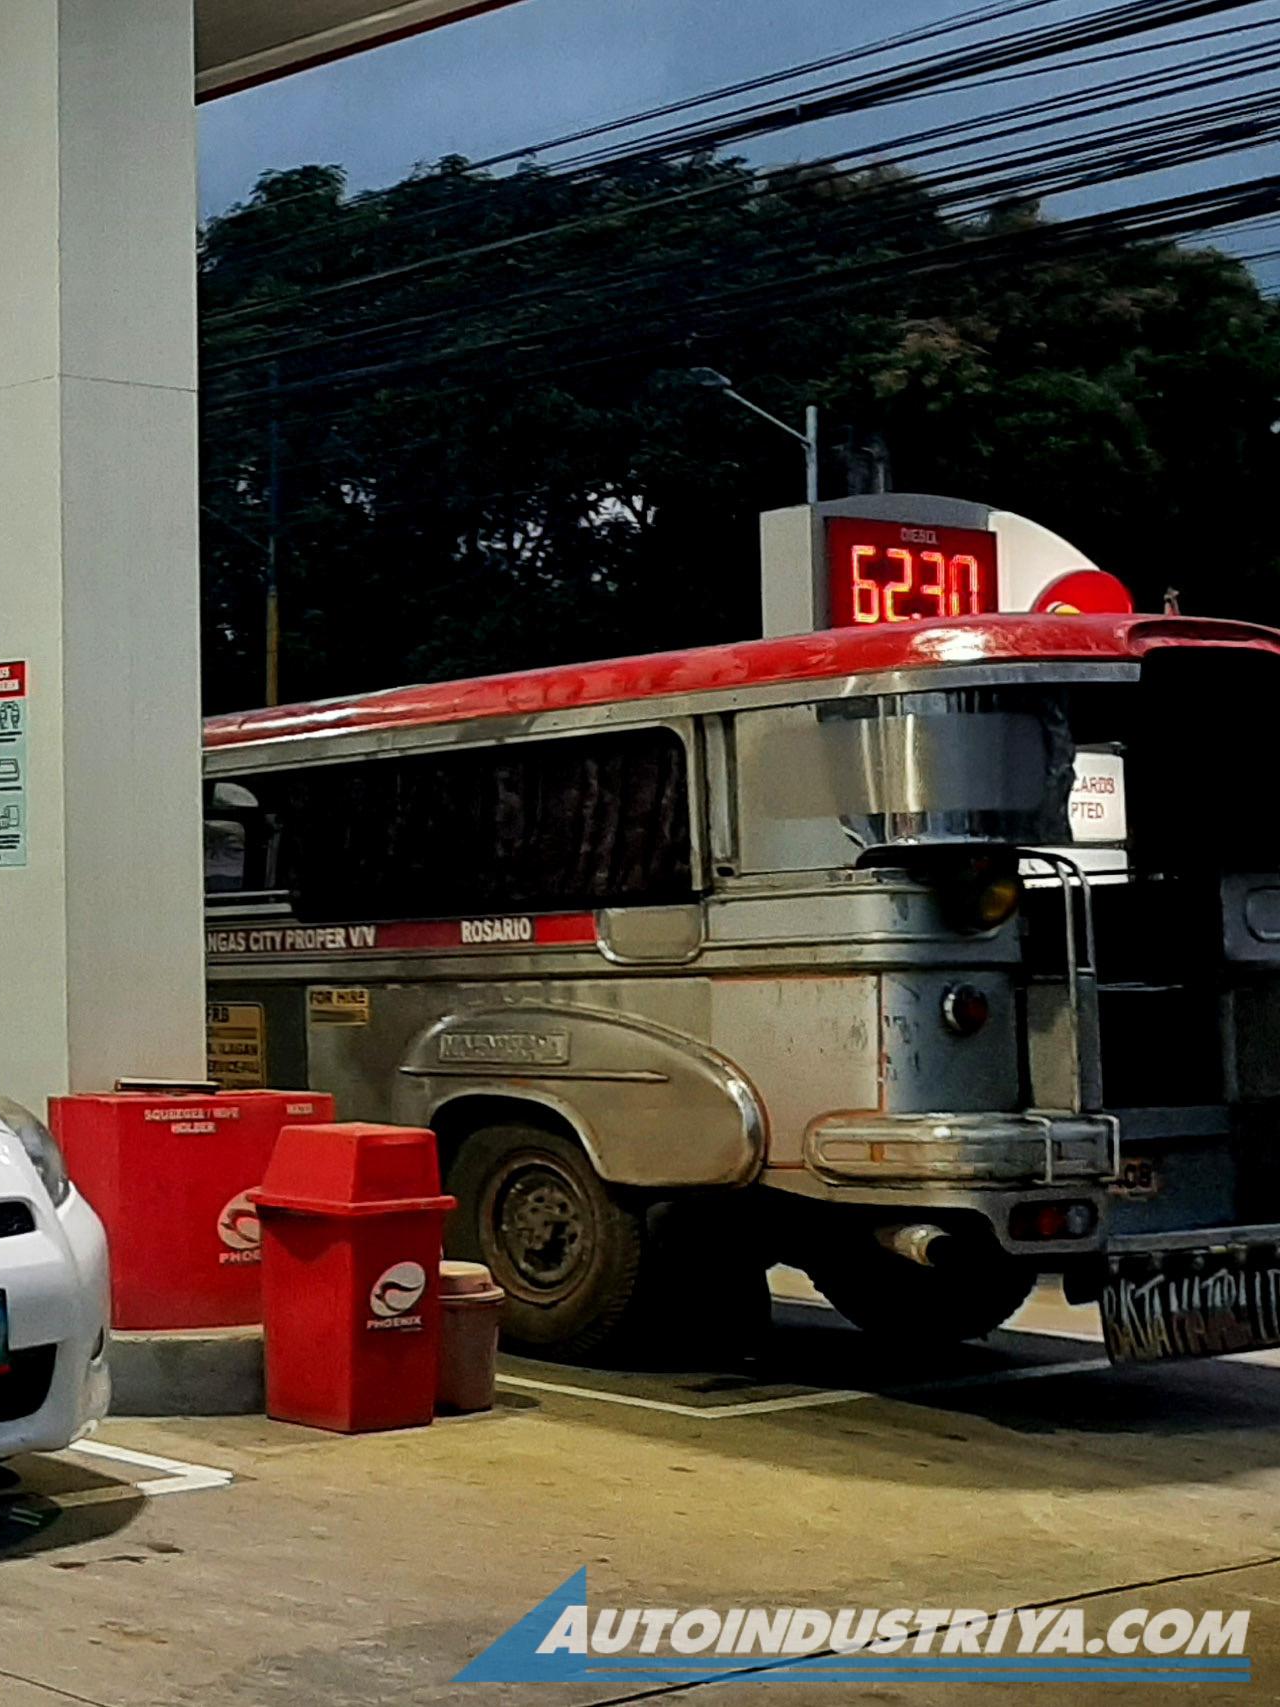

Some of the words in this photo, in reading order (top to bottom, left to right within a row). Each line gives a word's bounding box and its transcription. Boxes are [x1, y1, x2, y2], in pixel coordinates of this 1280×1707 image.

[249, 930, 283, 950] CITY
[285, 926, 347, 950] PROPER
[460, 916, 532, 944] ROSARIO
[367, 1316, 422, 1329] PHOENIX
